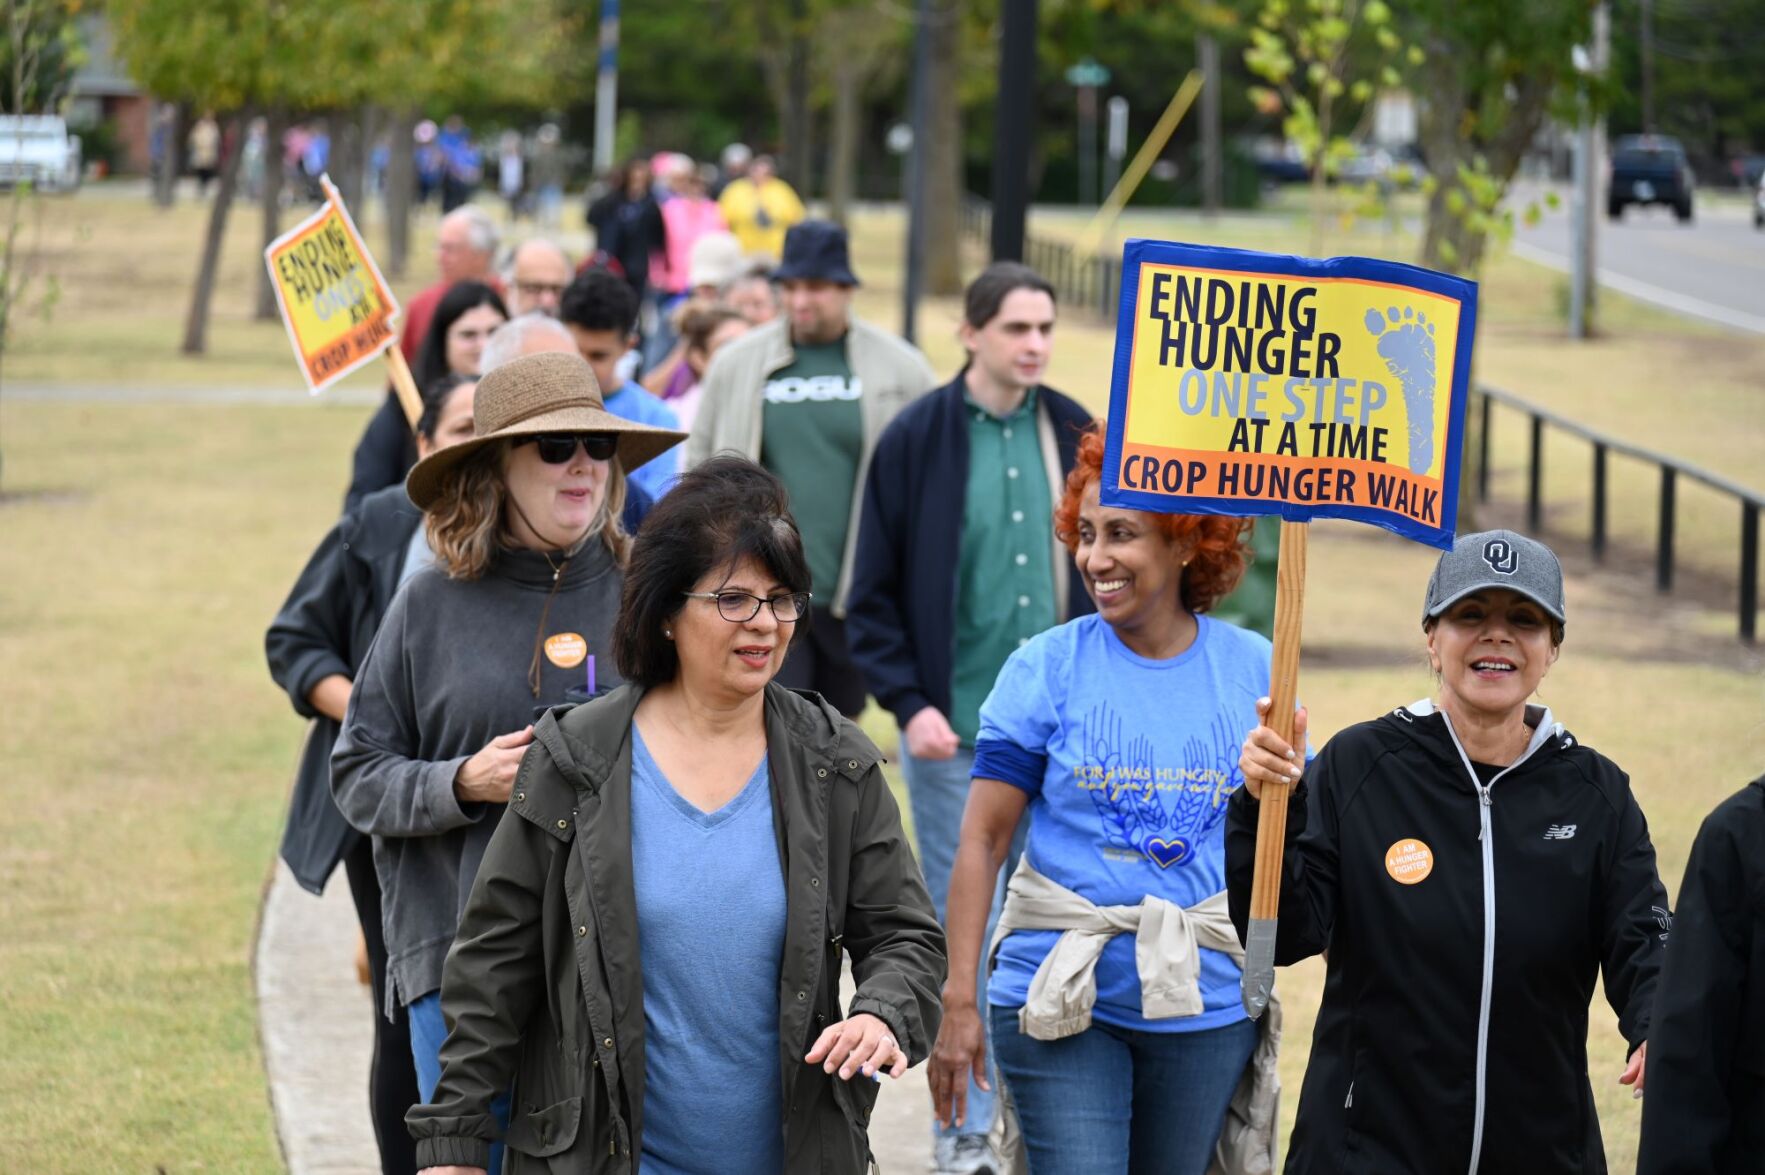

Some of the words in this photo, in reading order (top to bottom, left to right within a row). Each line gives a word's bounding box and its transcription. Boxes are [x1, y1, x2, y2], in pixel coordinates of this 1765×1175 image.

[1150, 273, 1318, 335] ENDING
[1159, 320, 1342, 378] HUNGER
[1179, 368, 1269, 419] ONE
[1281, 377, 1388, 426] STEP
[1228, 418, 1270, 453] AT
[1277, 421, 1298, 456] A
[1310, 422, 1389, 463] TIME
[1123, 454, 1207, 494] CROP
[1218, 463, 1356, 502] HUNGER
[1367, 472, 1438, 523] WALK
[1482, 539, 1519, 575] OU
[1073, 766, 1104, 779] FOR
[1119, 767, 1151, 780] WAS
[1395, 860, 1428, 875] FIGHTER
[1396, 850, 1428, 865] HUNGER
[1404, 843, 1416, 854] AM
